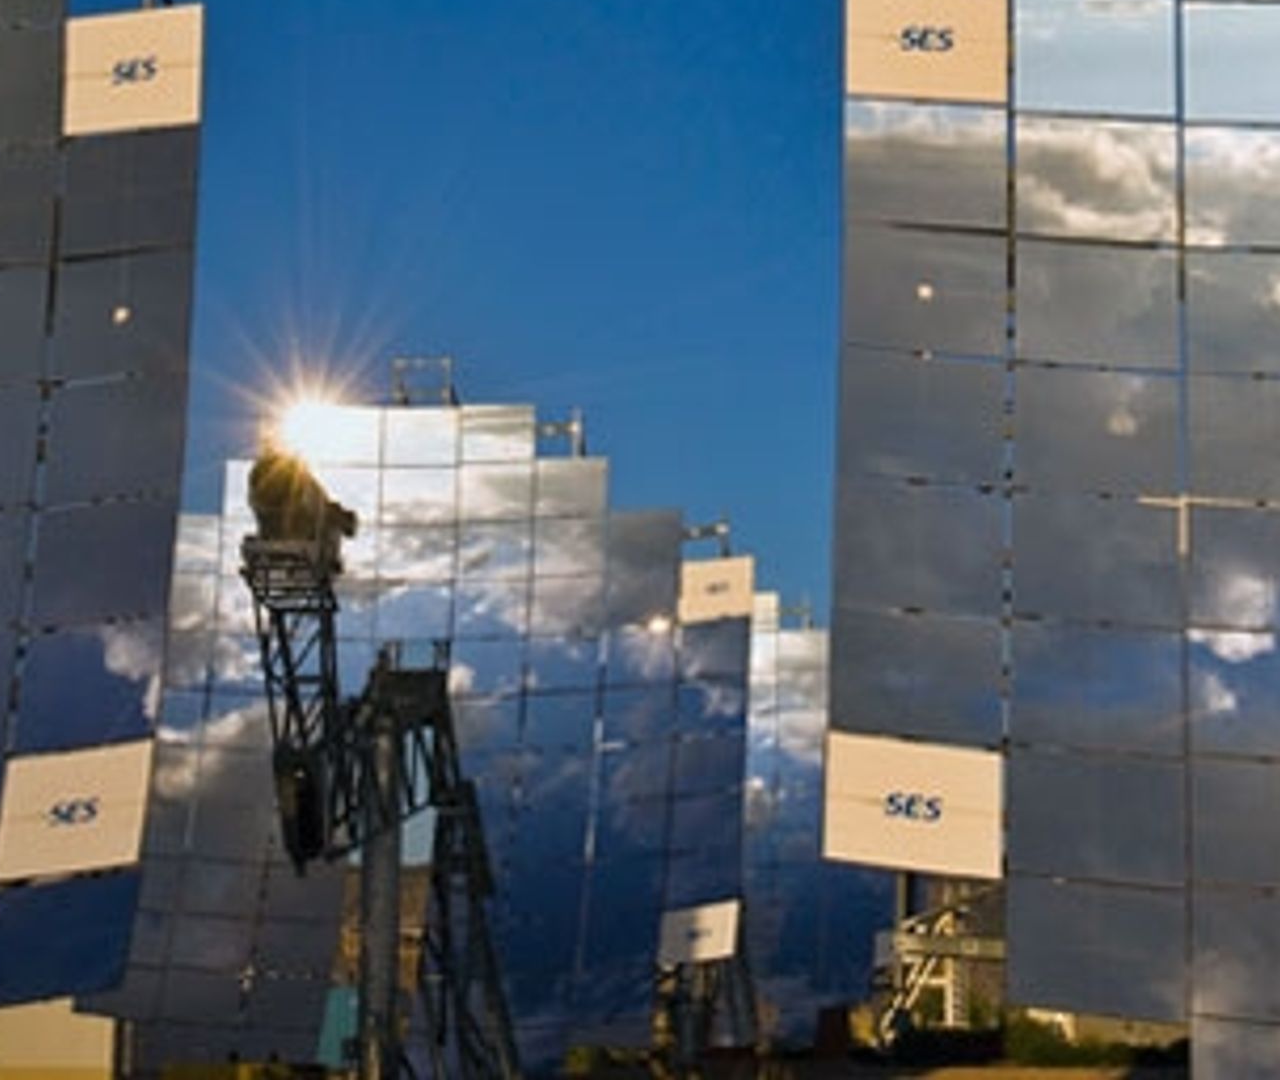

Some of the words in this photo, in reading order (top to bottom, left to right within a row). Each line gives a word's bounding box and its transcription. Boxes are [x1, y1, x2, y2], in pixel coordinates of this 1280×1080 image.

[900, 26, 954, 52] SES
[112, 55, 158, 86] SES
[49, 798, 98, 825] SES
[885, 792, 942, 821] SES
